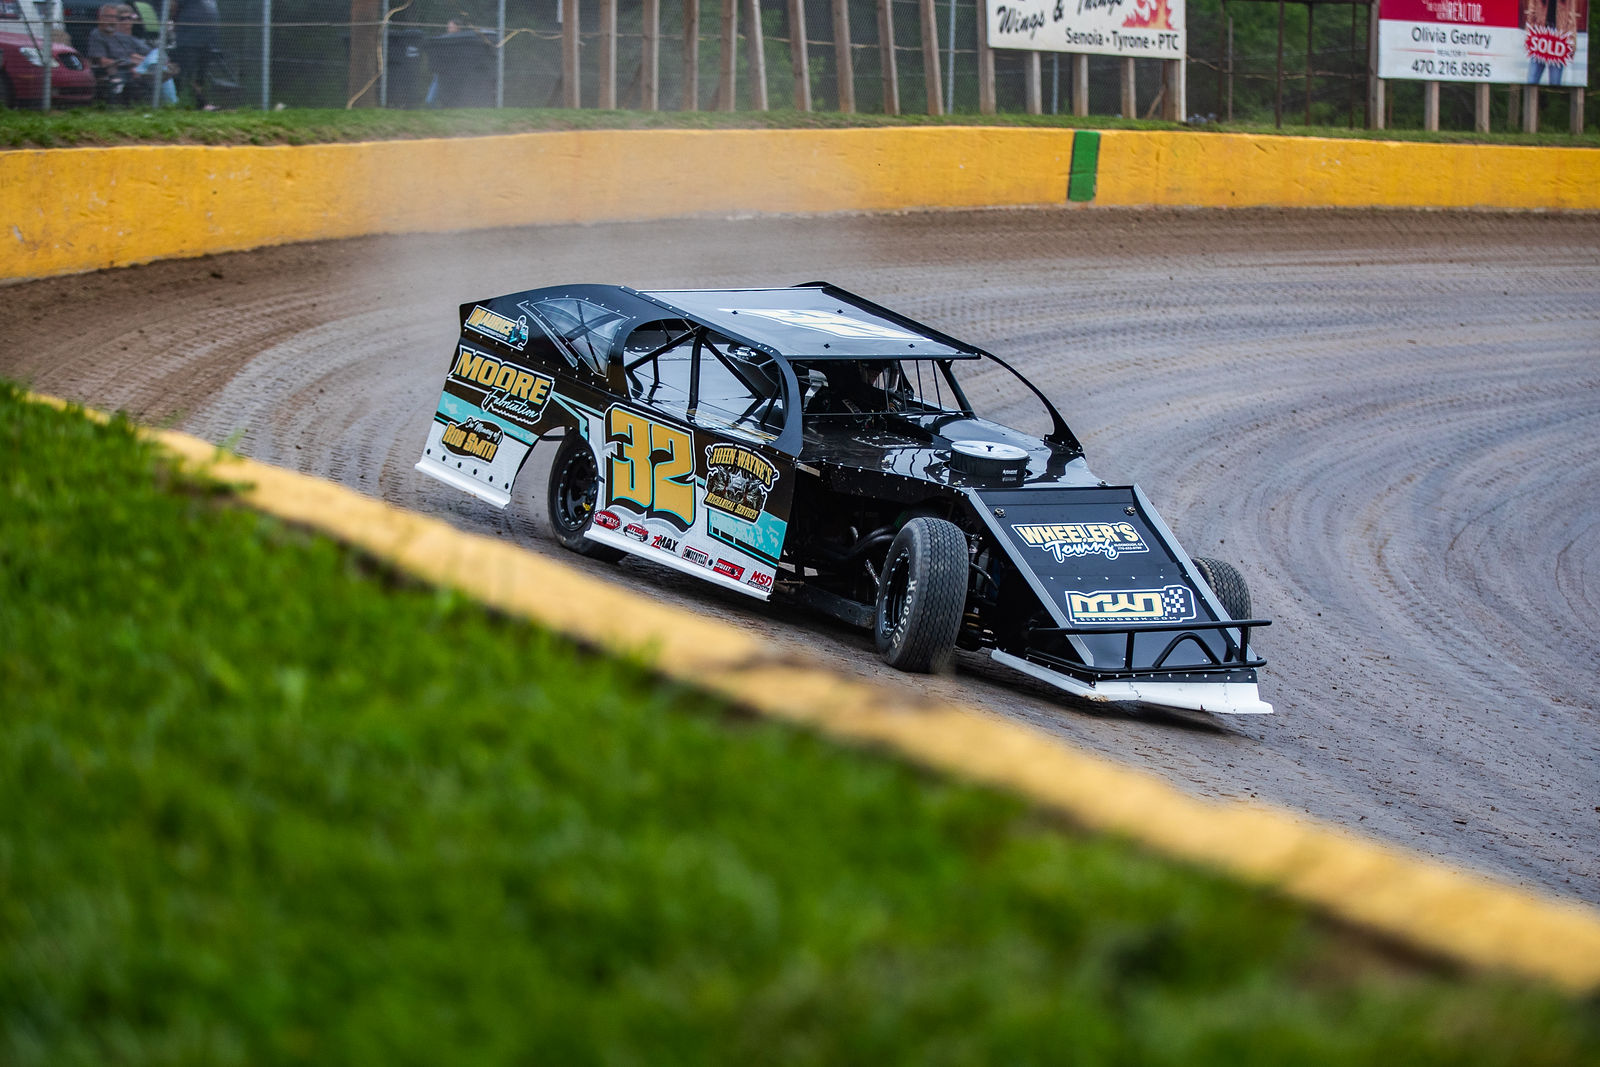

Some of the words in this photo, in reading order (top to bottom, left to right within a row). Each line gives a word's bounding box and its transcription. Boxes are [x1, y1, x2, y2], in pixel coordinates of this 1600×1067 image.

[996, 5, 1045, 40] Wings
[1065, 27, 1104, 46] Senoia
[1111, 30, 1150, 51] Tyrone
[1158, 33, 1180, 50] PTC
[1411, 26, 1447, 44] Olivia
[1450, 29, 1492, 49] Gentry
[1529, 36, 1567, 57] SOLD
[1411, 59, 1492, 78] 470.216.8995
[454, 351, 551, 405] MOORE
[484, 386, 540, 418] Fabrication
[462, 432, 499, 461] SMITH
[611, 406, 696, 526] 32
[709, 447, 738, 465] JOHN
[736, 449, 773, 486] WAYNE'S
[1016, 524, 1140, 544] WHEELER'S
[1044, 537, 1116, 561] Towing
[750, 570, 774, 588] MSD
